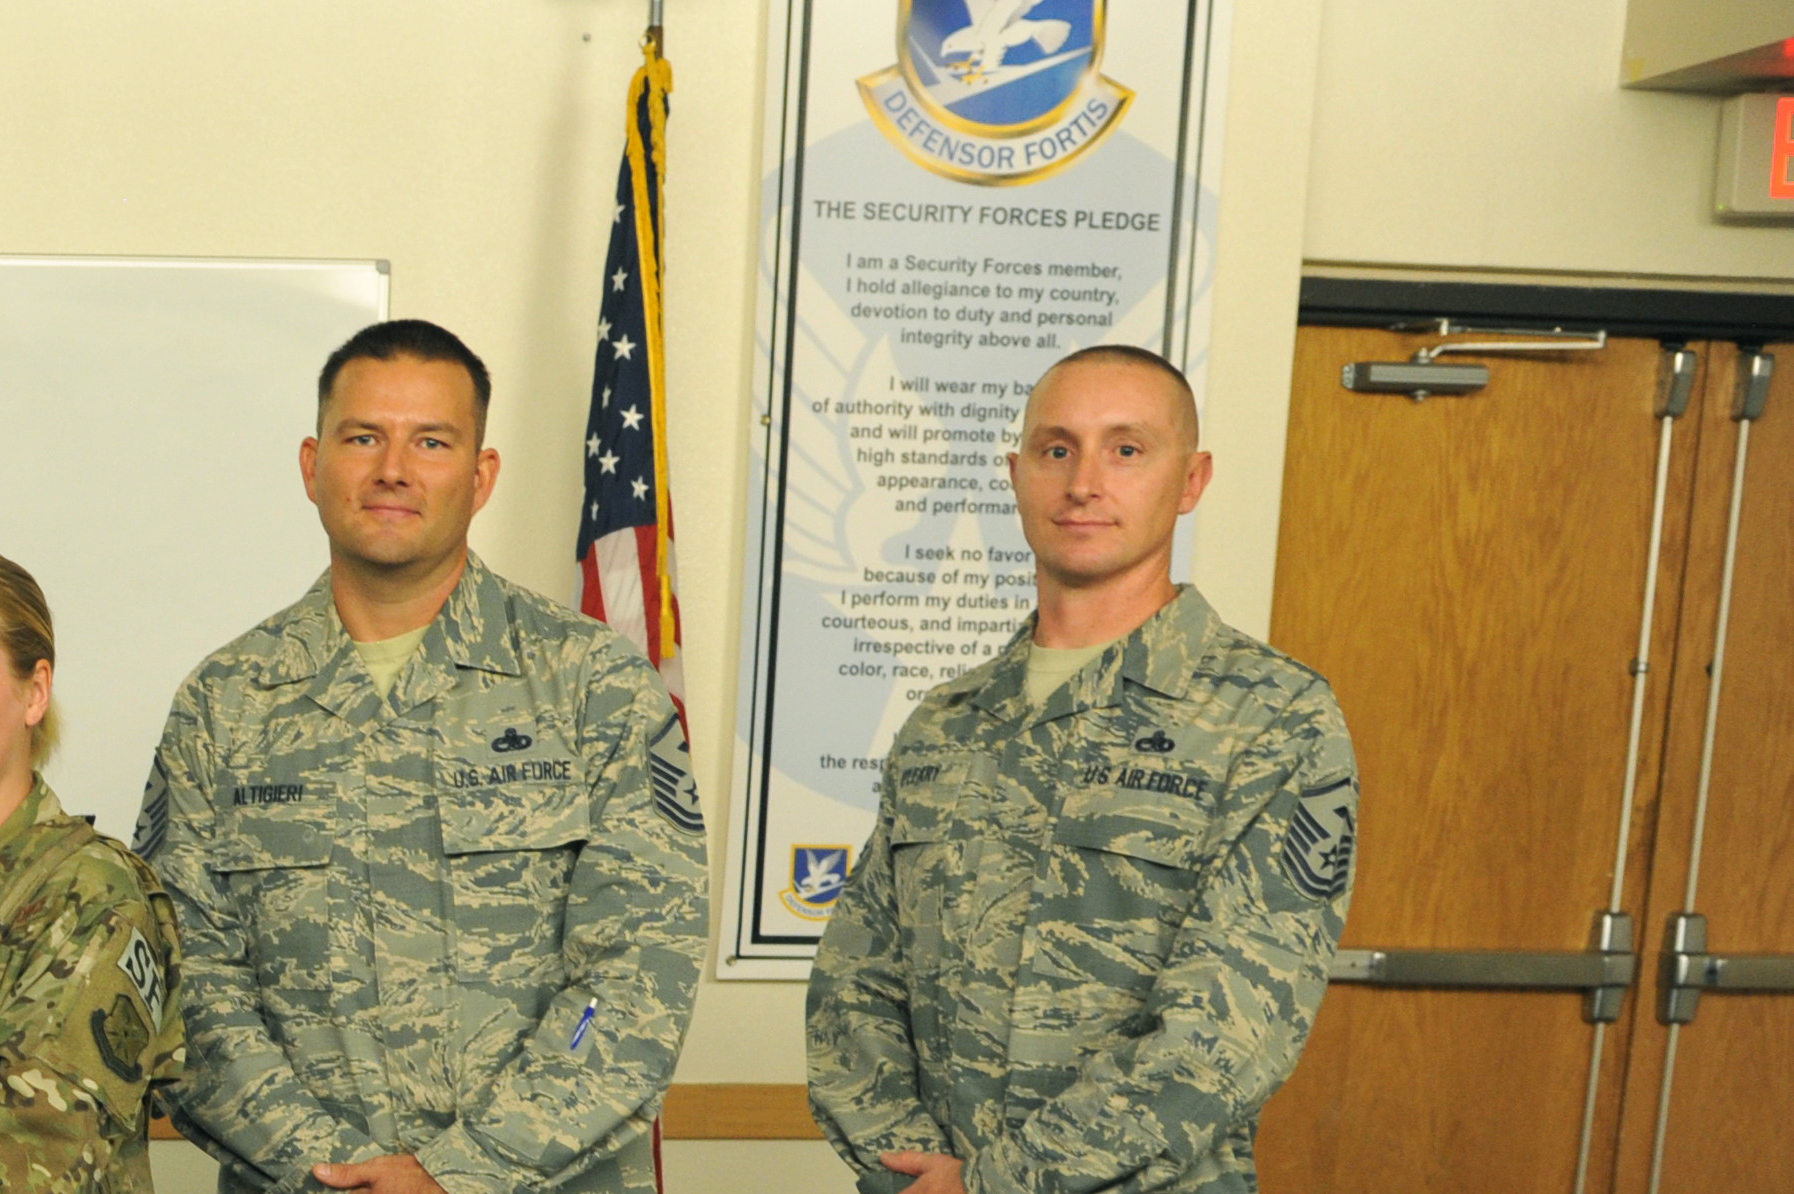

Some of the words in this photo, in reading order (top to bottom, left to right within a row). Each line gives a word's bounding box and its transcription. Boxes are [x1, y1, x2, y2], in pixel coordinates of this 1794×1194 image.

[884, 90, 1015, 168] DEFENSOR
[1025, 98, 1110, 166] FORTIS
[814, 200, 855, 219] THE
[863, 202, 972, 223] SECURITY
[979, 206, 1067, 228] FORCES
[1074, 210, 1160, 232] PLEDGE
[857, 257, 882, 268] am
[889, 258, 898, 270] a
[905, 255, 977, 277] Security
[983, 258, 1042, 276] Forces
[1048, 262, 1121, 280] member,
[857, 278, 895, 294] hold
[901, 280, 990, 300] allegiance
[996, 284, 1013, 299] to
[1018, 288, 1044, 304] my
[1050, 288, 1119, 306] country,
[851, 303, 927, 319] devotion
[934, 307, 950, 321] to
[956, 306, 994, 326] duty
[1000, 309, 1032, 323] and
[1037, 312, 1112, 327] personal
[901, 328, 973, 349] integrity
[978, 331, 1031, 348] above
[1036, 334, 1060, 348] all.
[900, 377, 929, 392] will
[935, 382, 976, 394] wear
[982, 383, 1008, 399] my
[811, 398, 830, 414] of
[835, 400, 913, 420] authority
[919, 402, 954, 417] with
[960, 403, 1019, 423] dignity
[850, 424, 883, 439] and
[888, 425, 917, 439] will
[923, 429, 995, 444] promote
[1001, 428, 1021, 447] by
[857, 448, 895, 467] high
[901, 450, 987, 467] standards
[993, 450, 1006, 467] o
[877, 475, 982, 492] appearance,
[895, 497, 927, 512] and
[915, 546, 954, 560] seek
[961, 550, 982, 561] no
[988, 546, 1031, 563] favor
[864, 567, 936, 584] because
[942, 569, 959, 584] of
[963, 573, 989, 589] my
[851, 590, 919, 609] perform
[925, 596, 951, 611] my
[956, 593, 1009, 610] duties
[1014, 594, 1029, 609] in
[822, 616, 913, 632] courteous,
[920, 616, 951, 631] and
[957, 616, 1017, 635] imparti
[854, 638, 955, 657] irrespective
[960, 640, 978, 655] of
[982, 644, 992, 656] a
[839, 661, 886, 678] color,
[892, 665, 933, 679] race,
[820, 754, 846, 769] the
[454, 766, 484, 788] U.S.
[489, 764, 517, 785] AIR
[522, 761, 572, 782] FORCE
[1115, 768, 1144, 791] AIR
[1146, 771, 1210, 802] FORCE
[234, 784, 304, 806] ALTIGIERI
[126, 939, 161, 1013] SF
